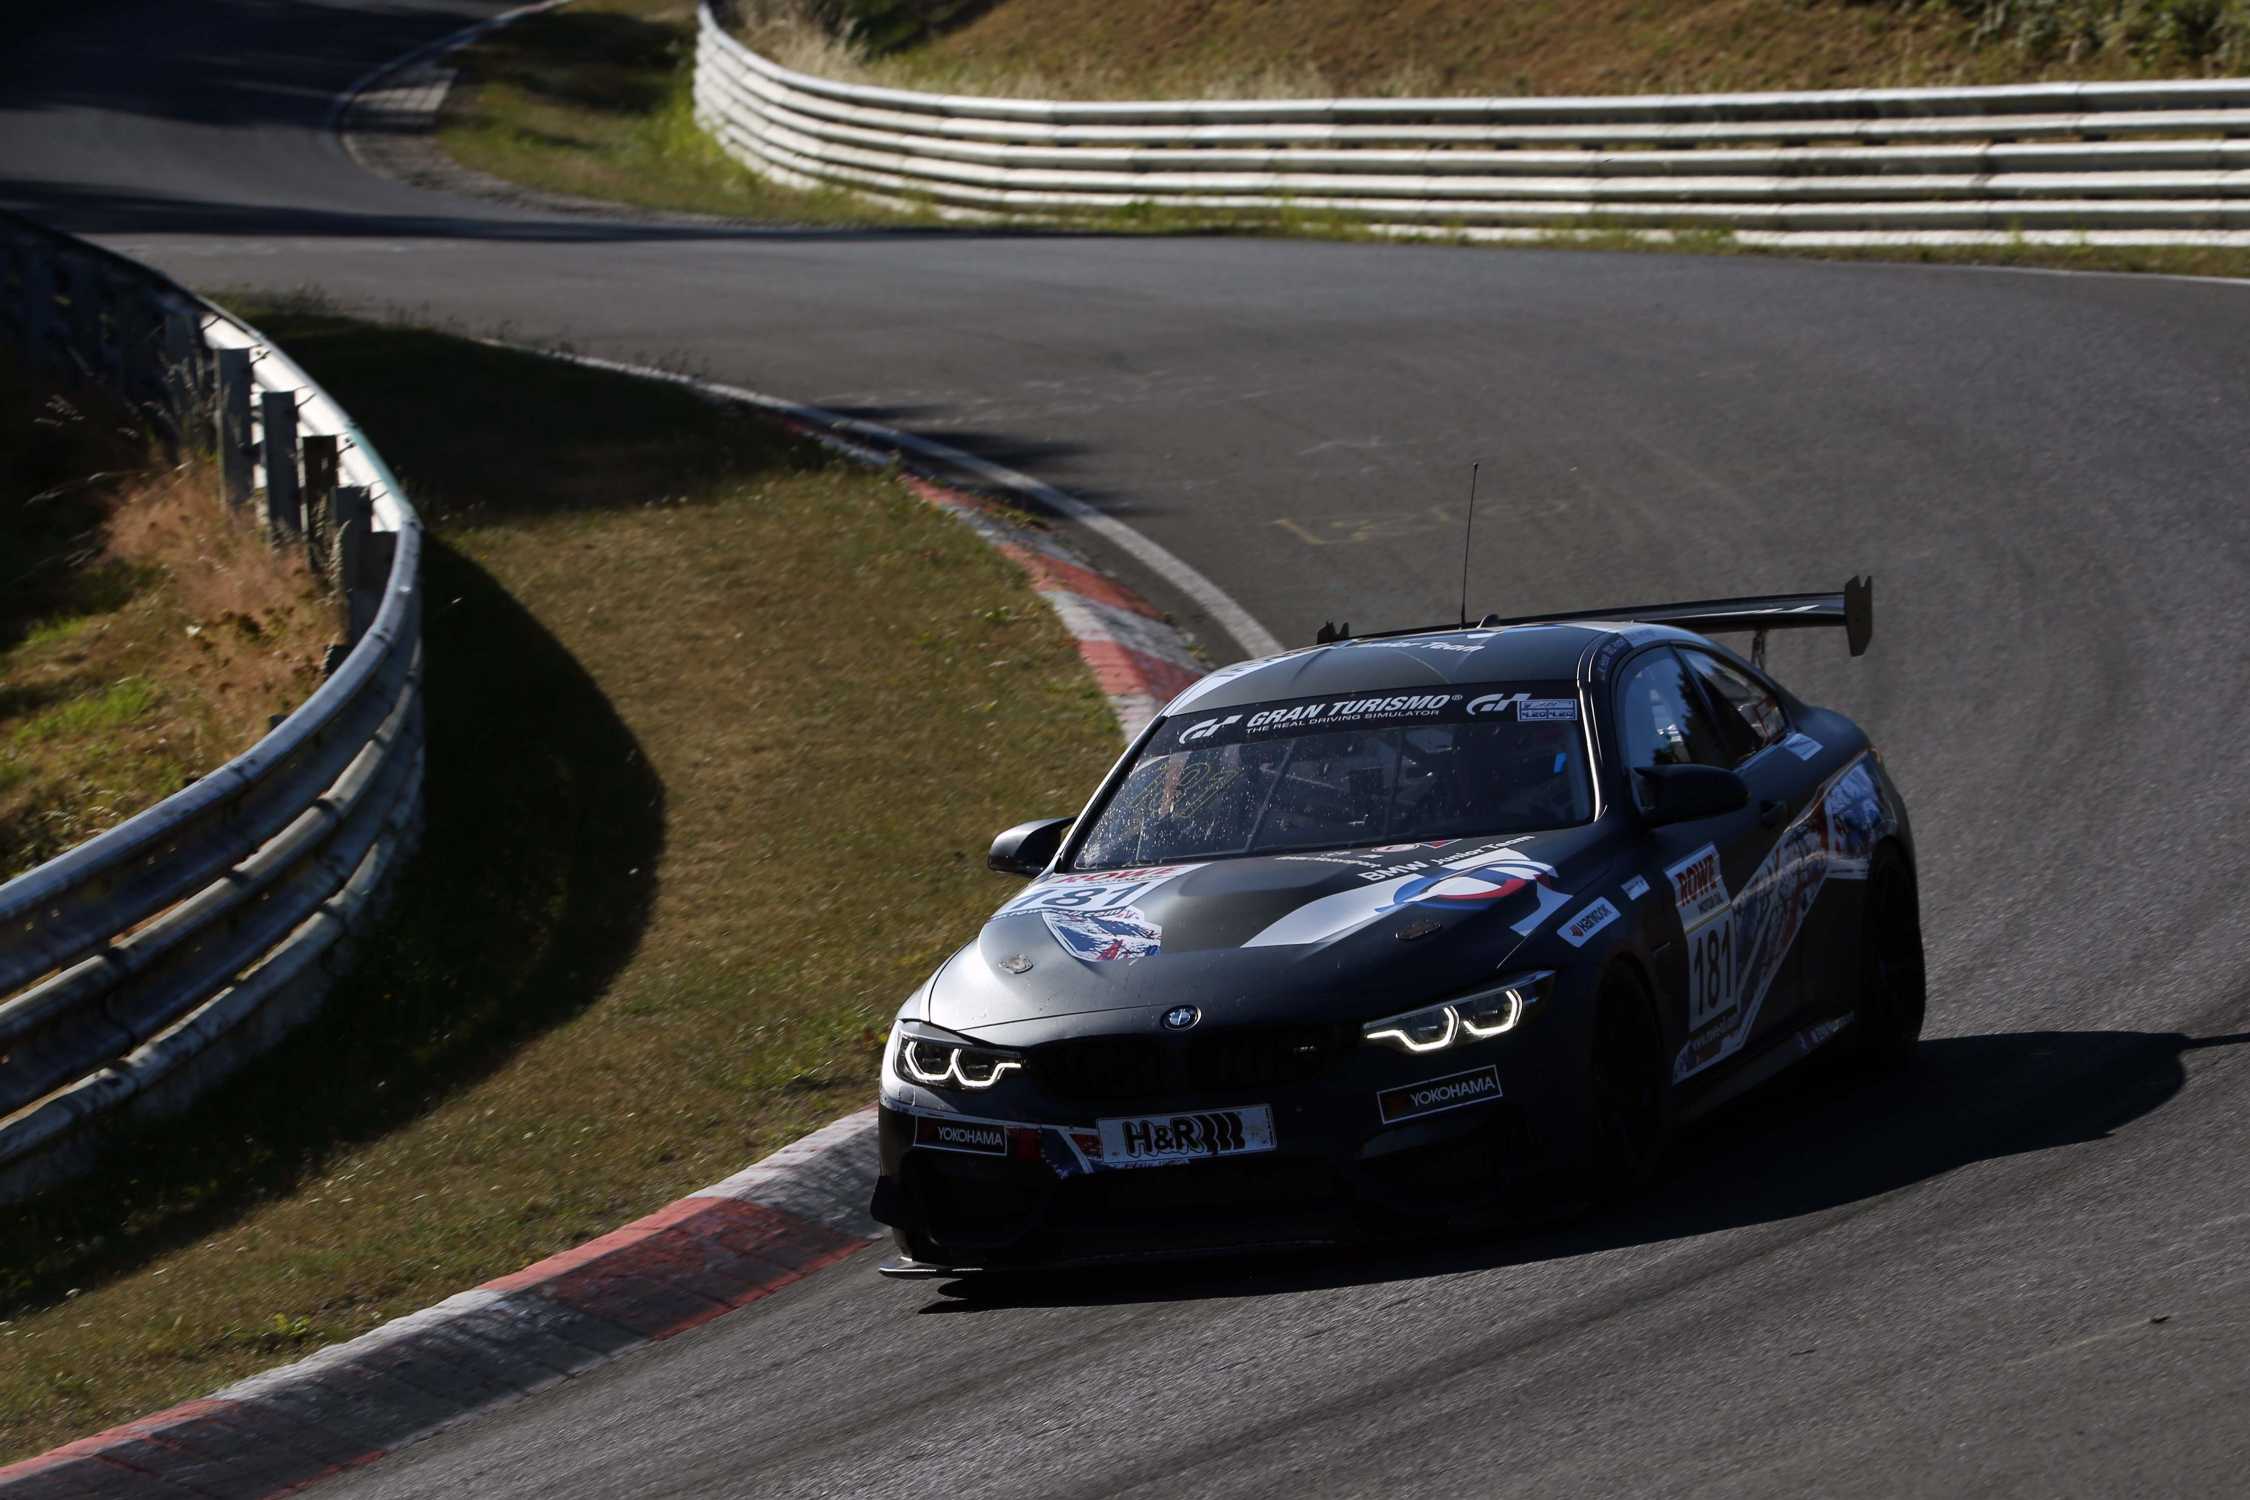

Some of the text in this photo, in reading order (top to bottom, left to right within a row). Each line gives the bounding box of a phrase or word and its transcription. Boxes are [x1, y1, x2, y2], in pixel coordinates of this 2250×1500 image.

[1246, 703, 1327, 728] GRAN
[1247, 709, 1440, 734] THE REAL DRIVING SIMULATOR
[1357, 860, 1430, 882] BMW
[1430, 848, 1485, 865] Junior
[1480, 835, 1537, 849] Team
[1009, 882, 1150, 910] 181
[1694, 922, 1732, 1016] 181
[1409, 1075, 1497, 1107] YOKOHAMA
[936, 1124, 1005, 1149] YOKOHAMA
